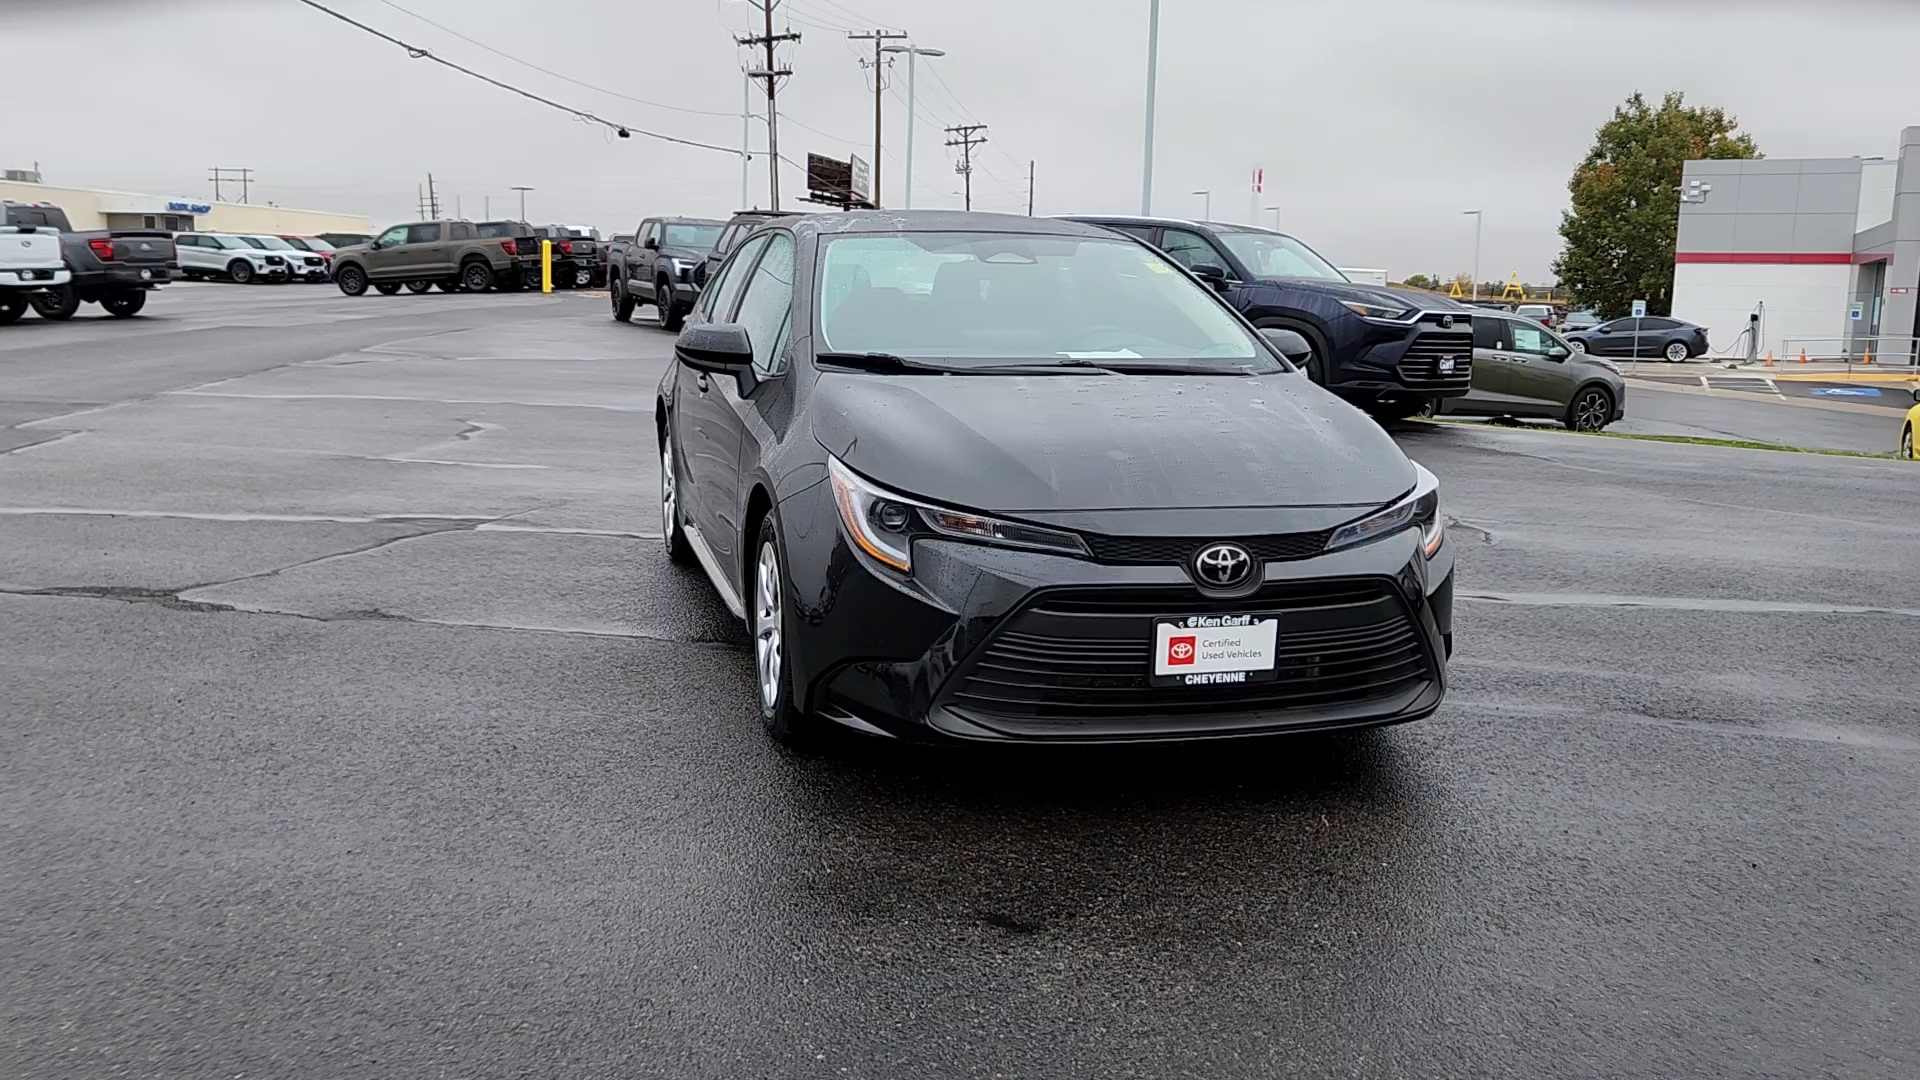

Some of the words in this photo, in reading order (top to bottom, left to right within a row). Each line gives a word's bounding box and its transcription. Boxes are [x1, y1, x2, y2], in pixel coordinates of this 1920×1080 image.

[1198, 616, 1221, 627] Ken
[1221, 614, 1251, 626] Garff
[1202, 638, 1241, 648] Certified
[1201, 651, 1224, 660] Used
[1226, 649, 1262, 659] Vehicles
[1185, 672, 1246, 685] CHEYENNE
